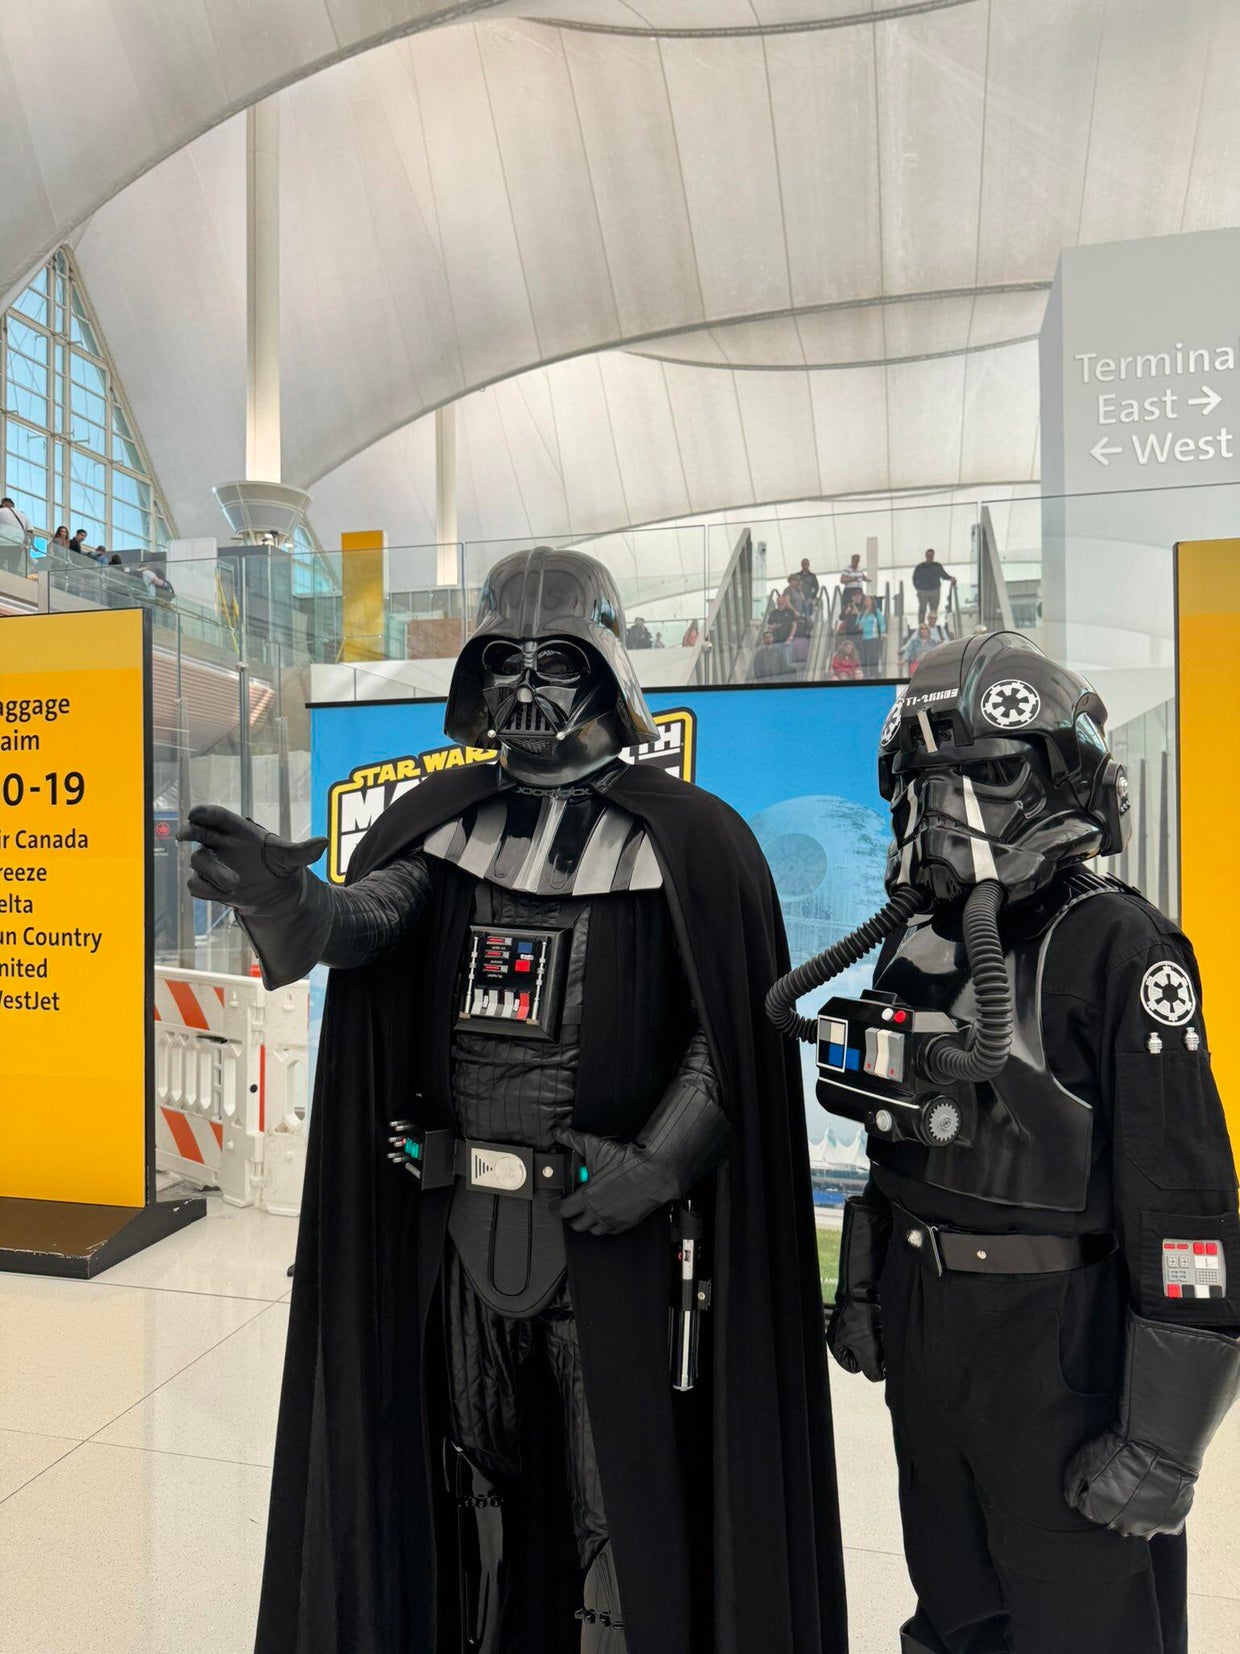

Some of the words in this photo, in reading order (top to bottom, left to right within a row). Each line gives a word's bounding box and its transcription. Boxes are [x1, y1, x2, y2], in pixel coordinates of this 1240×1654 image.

[1074, 342, 1240, 383] Termina
[1098, 388, 1178, 425] East
[1131, 427, 1234, 466] West
[2, 771, 85, 806] 0-19
[352, 759, 421, 787] STAR
[15, 828, 89, 849] Canada
[23, 926, 103, 954] Country
[0, 990, 60, 1011] estJet
